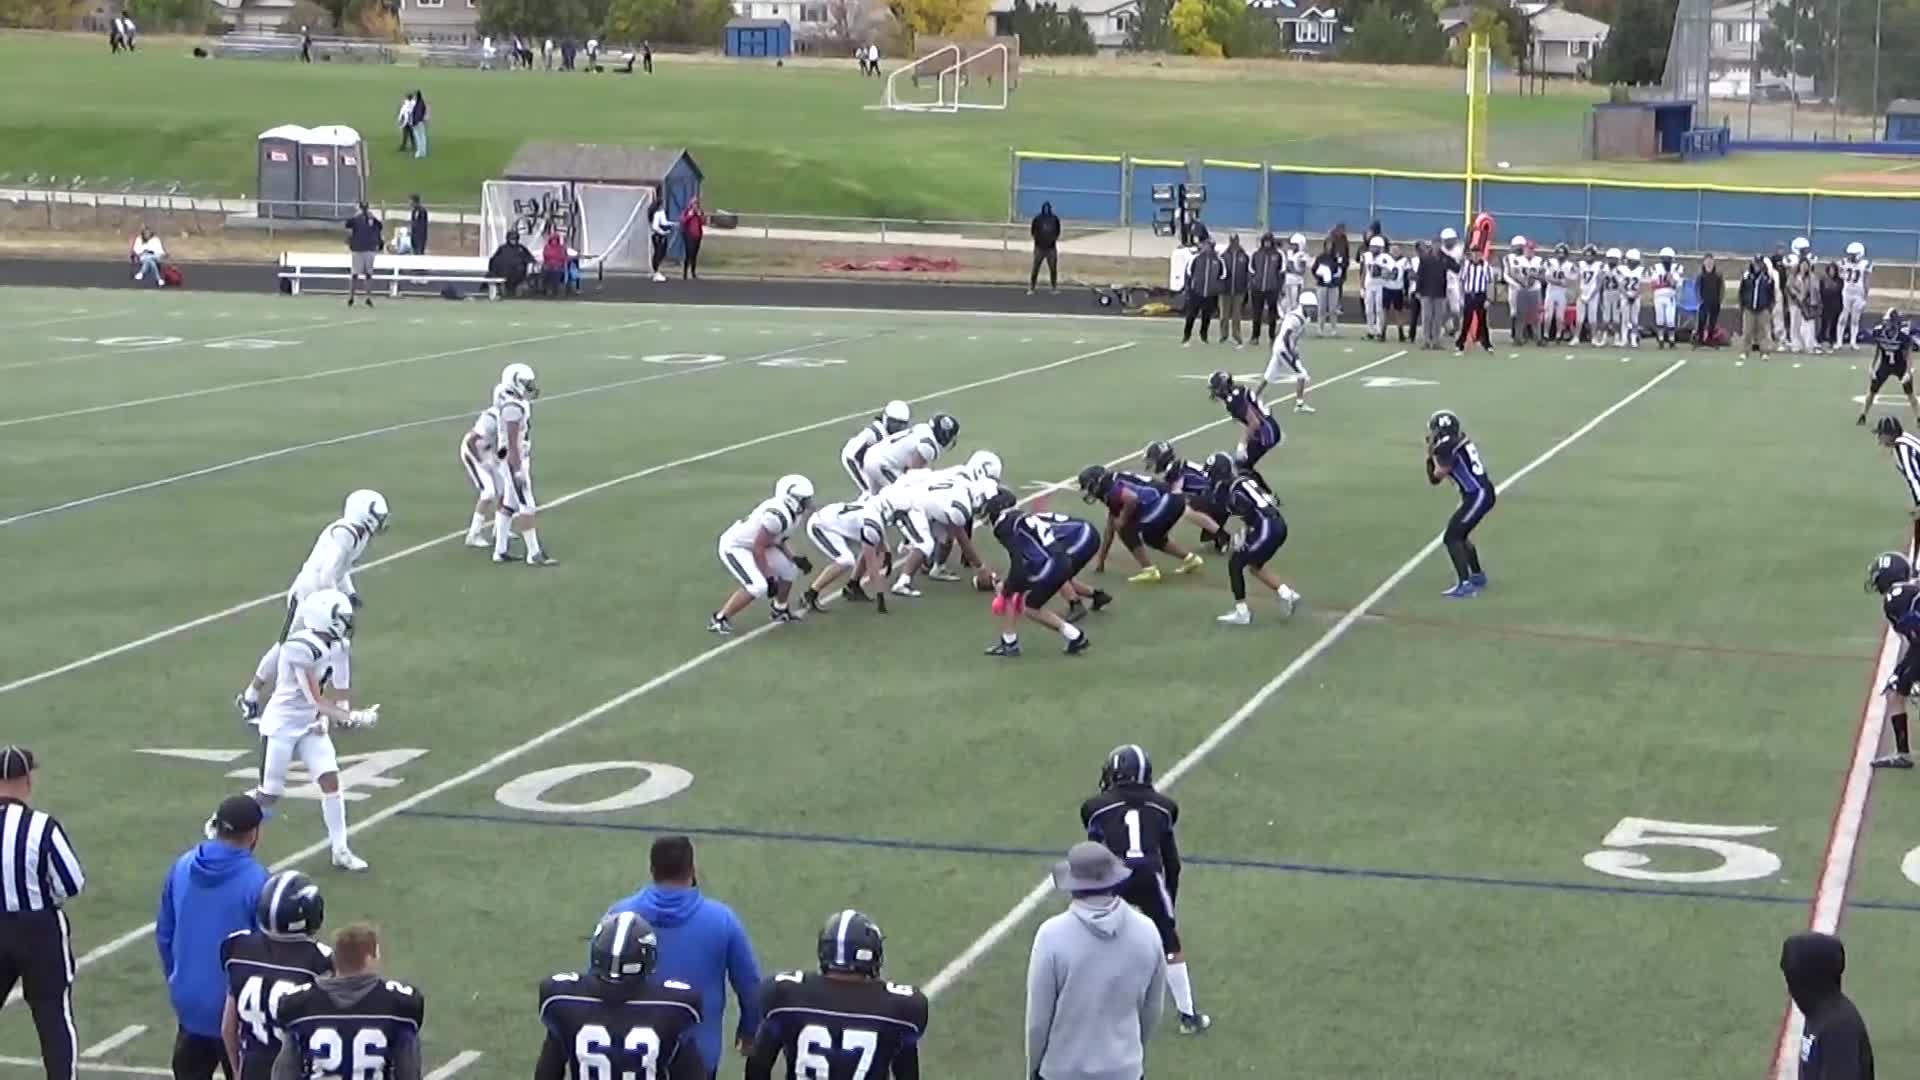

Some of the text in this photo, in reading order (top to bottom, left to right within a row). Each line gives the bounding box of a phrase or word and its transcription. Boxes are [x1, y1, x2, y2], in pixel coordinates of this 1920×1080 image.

[494, 761, 695, 813] 0
[1124, 809, 1145, 858] 1
[1582, 816, 1783, 882] 5
[309, 1027, 387, 1080] 26
[576, 1024, 661, 1080] 63
[795, 1024, 878, 1080] 67
